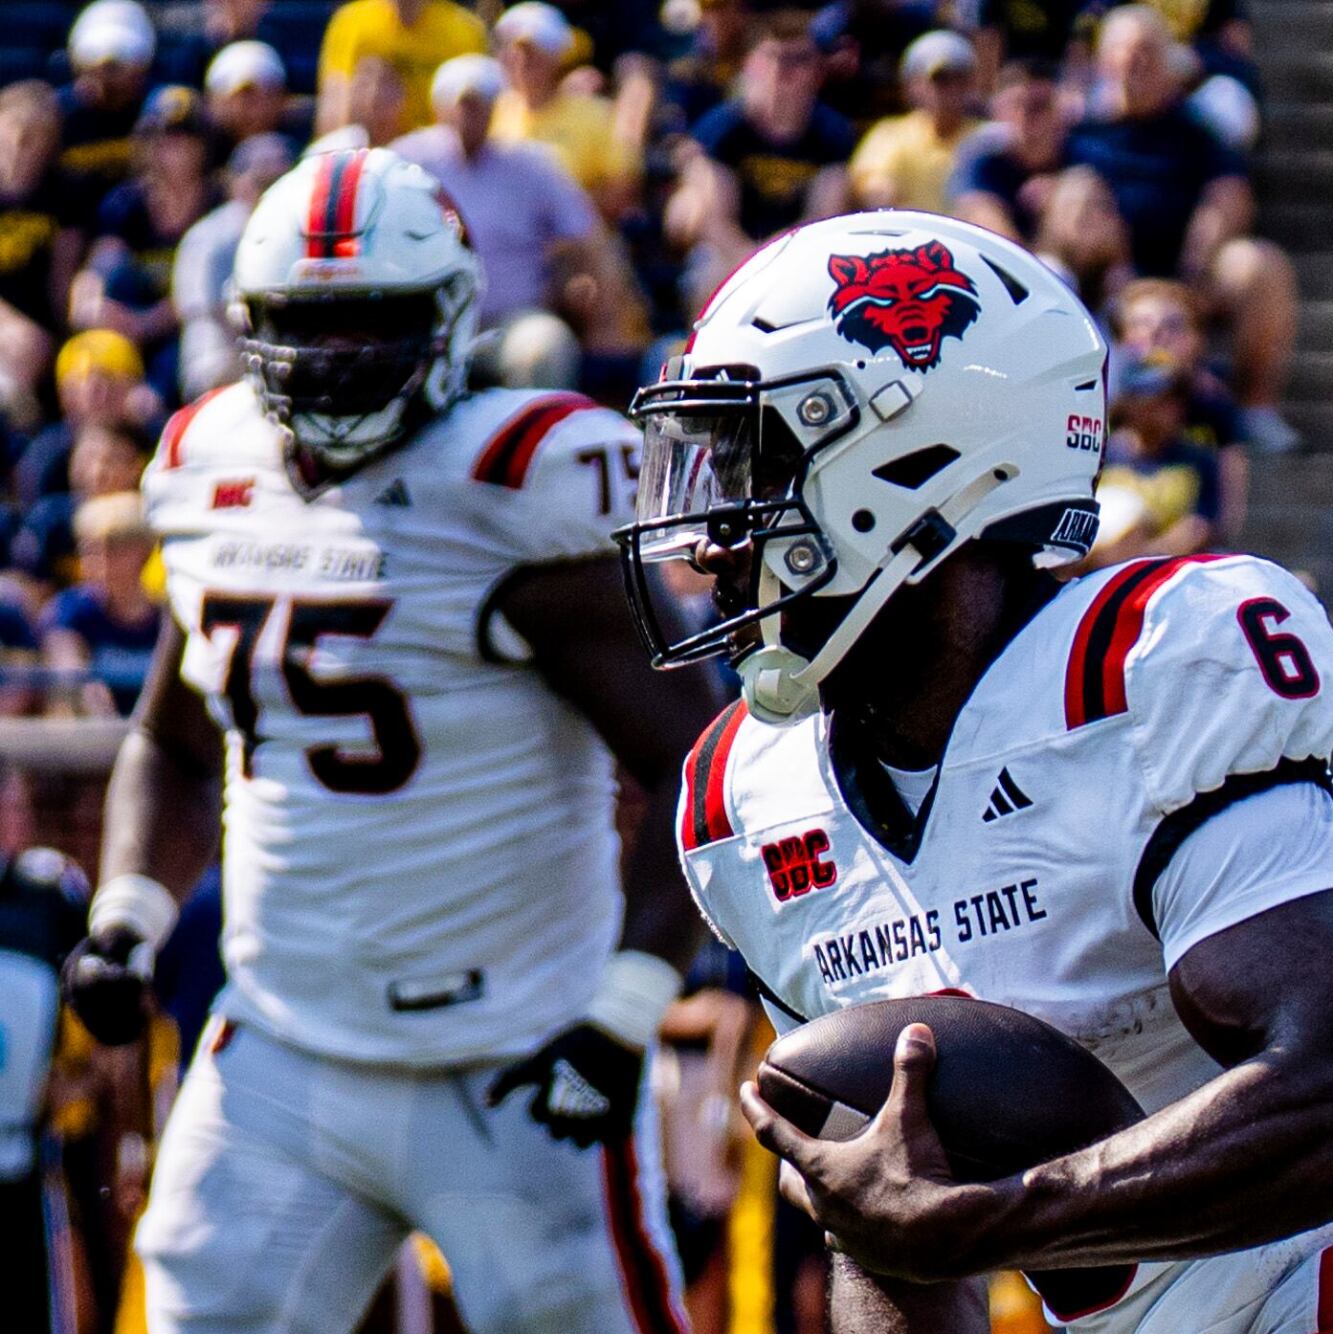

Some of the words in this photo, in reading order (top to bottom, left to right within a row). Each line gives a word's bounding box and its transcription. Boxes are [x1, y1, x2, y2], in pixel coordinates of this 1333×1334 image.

[201, 592, 423, 796] 75
[1236, 597, 1321, 700] 6
[812, 909, 943, 984] ARKANSAS
[954, 877, 1047, 942] STATE
